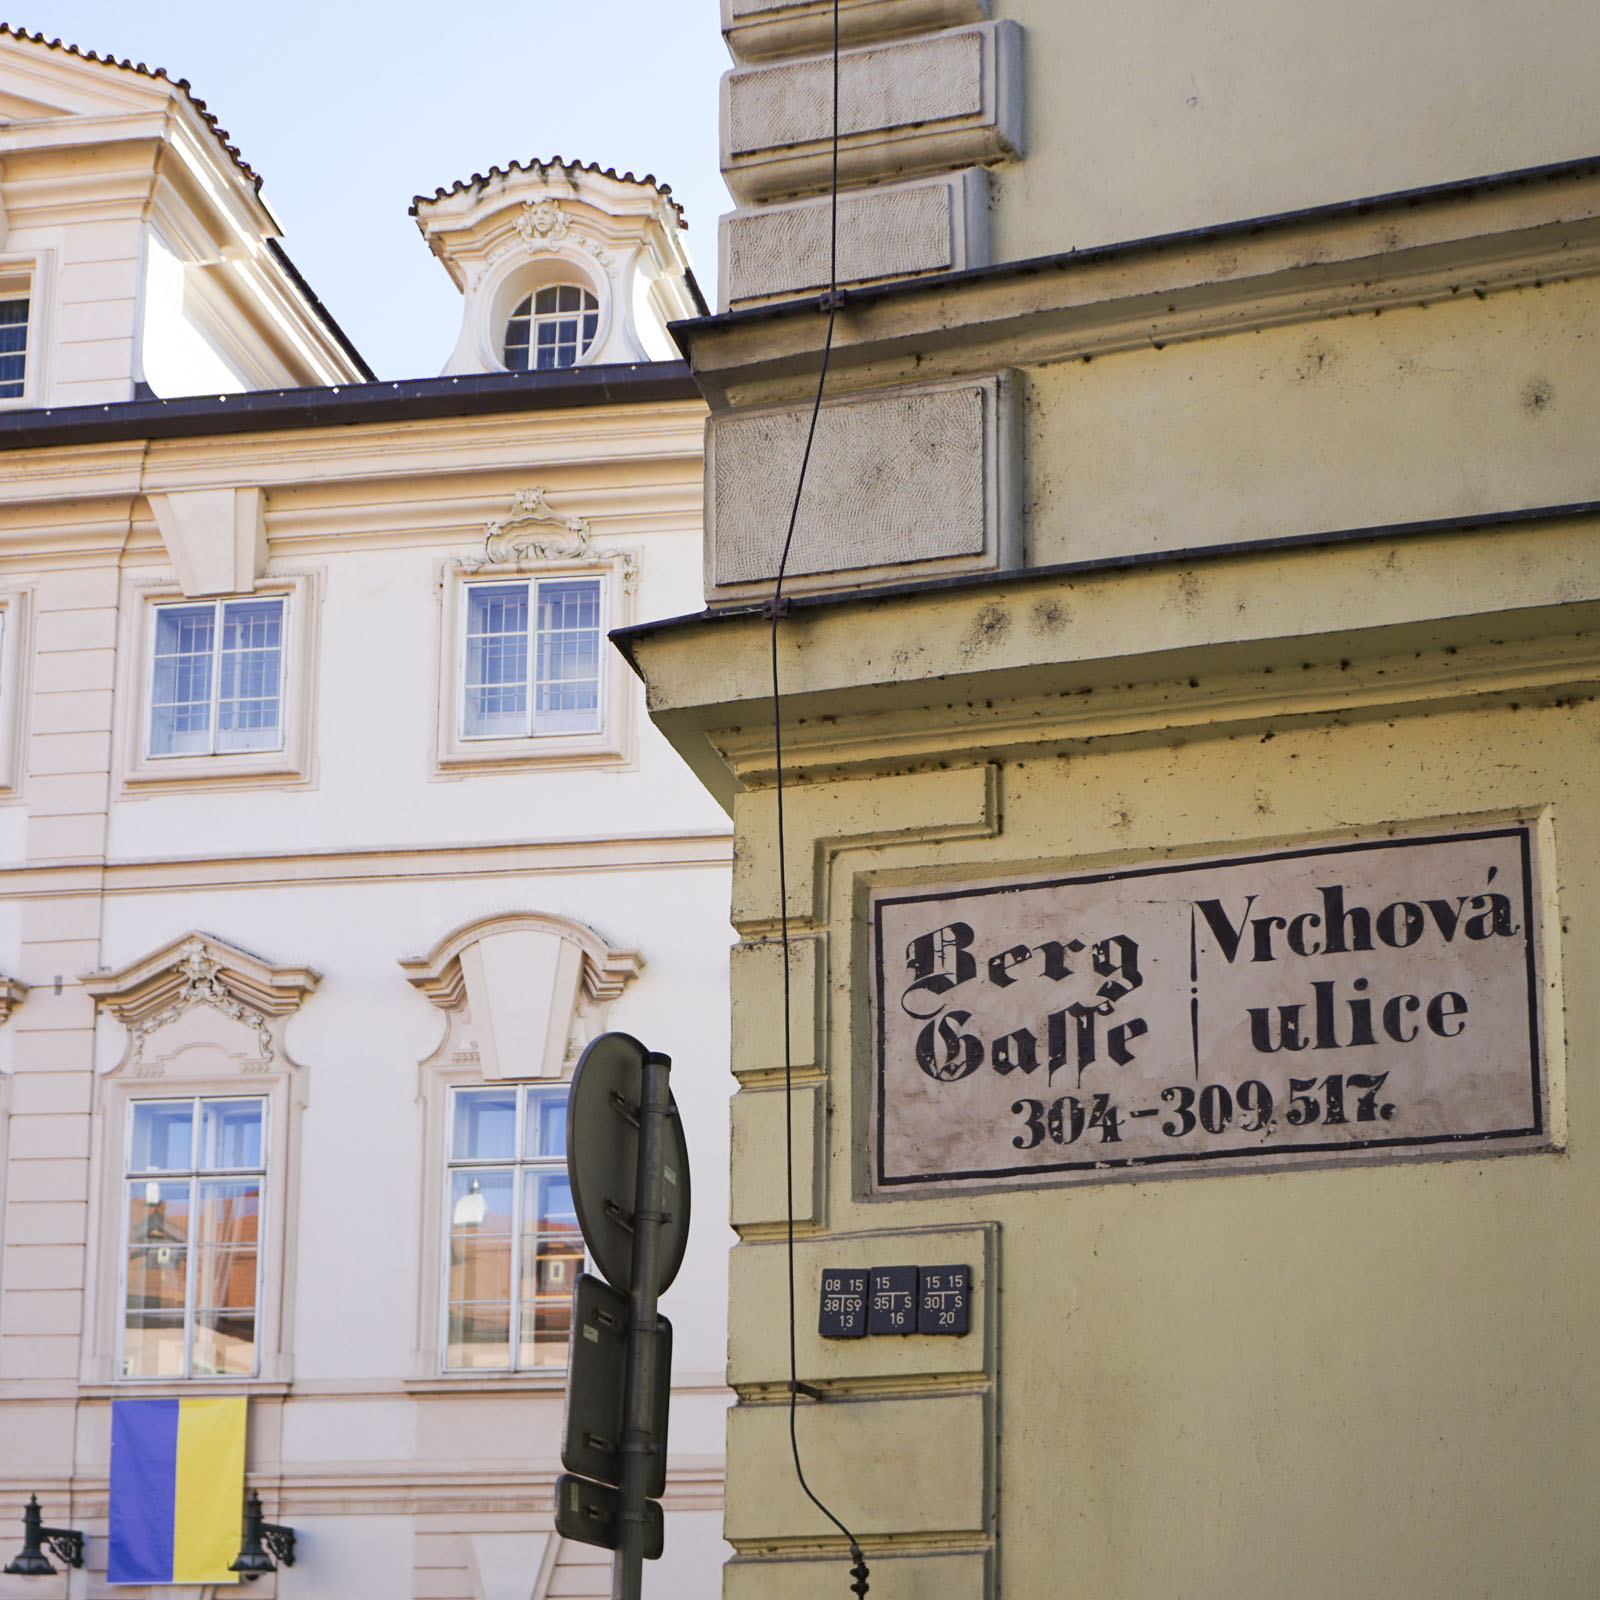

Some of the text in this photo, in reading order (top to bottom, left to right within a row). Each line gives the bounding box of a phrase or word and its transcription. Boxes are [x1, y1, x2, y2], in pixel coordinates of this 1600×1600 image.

[1193, 866, 1521, 964] Vrchová
[901, 921, 1144, 1020] Berg
[1245, 977, 1469, 1054] ulice
[825, 1279, 864, 1291] 08 15
[876, 1276, 890, 1289] 15
[925, 1275, 963, 1288] 15 15
[824, 1299, 840, 1312] 38
[873, 1296, 912, 1310] 35 S
[924, 1295, 962, 1309] 30 S
[840, 1315, 854, 1328] 13
[890, 1312, 904, 1325] 16
[939, 1311, 955, 1324] 20
